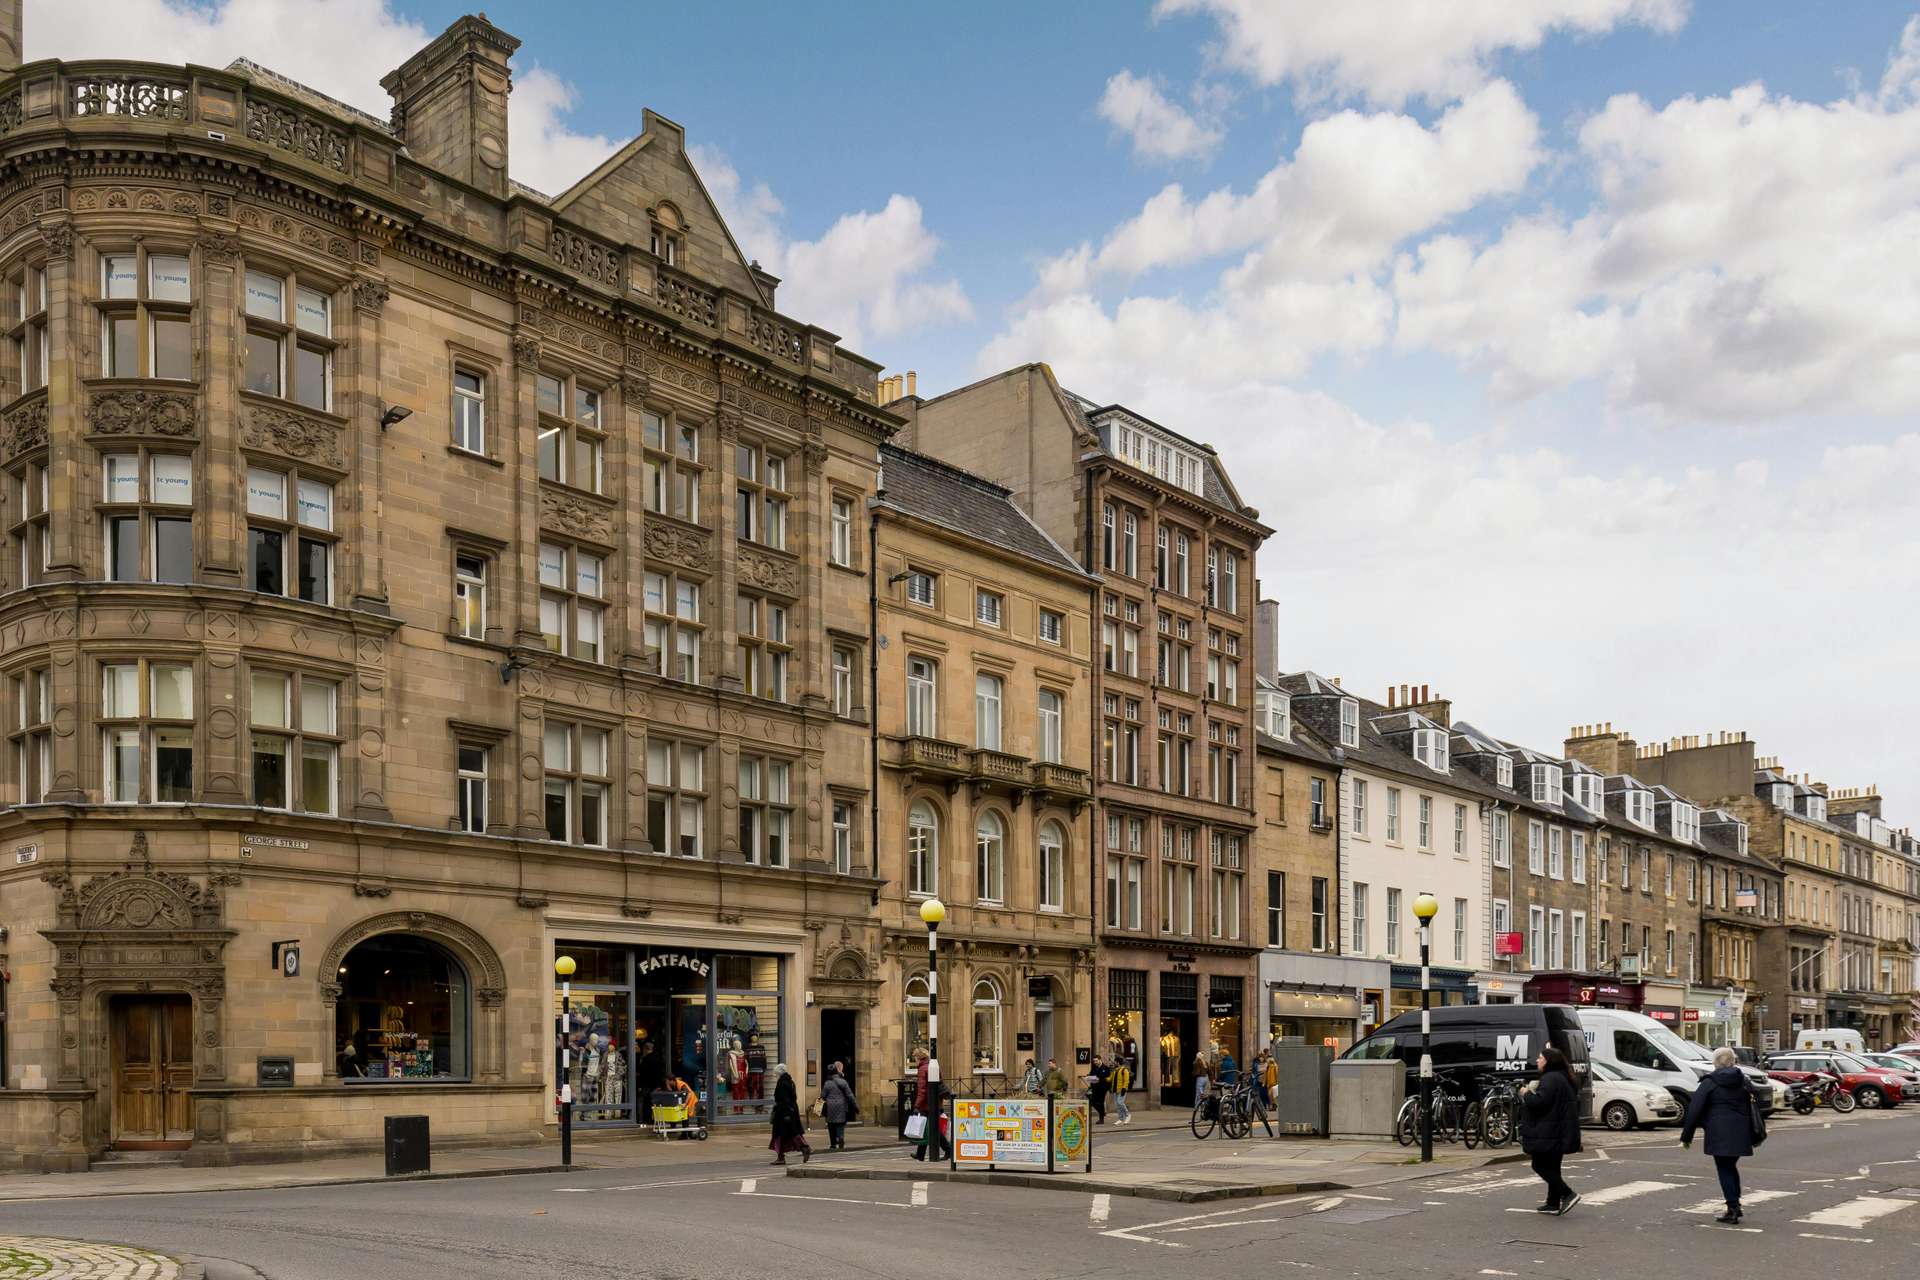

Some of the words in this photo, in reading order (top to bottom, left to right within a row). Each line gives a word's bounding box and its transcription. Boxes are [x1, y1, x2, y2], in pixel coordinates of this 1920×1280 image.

[246, 836, 277, 845] GEORGE
[280, 839, 310, 848] STREET
[639, 954, 710, 977] FATFACE
[1496, 1034, 1529, 1060] M
[1080, 1050, 1088, 1060] 67
[1496, 1061, 1528, 1071] PACT
